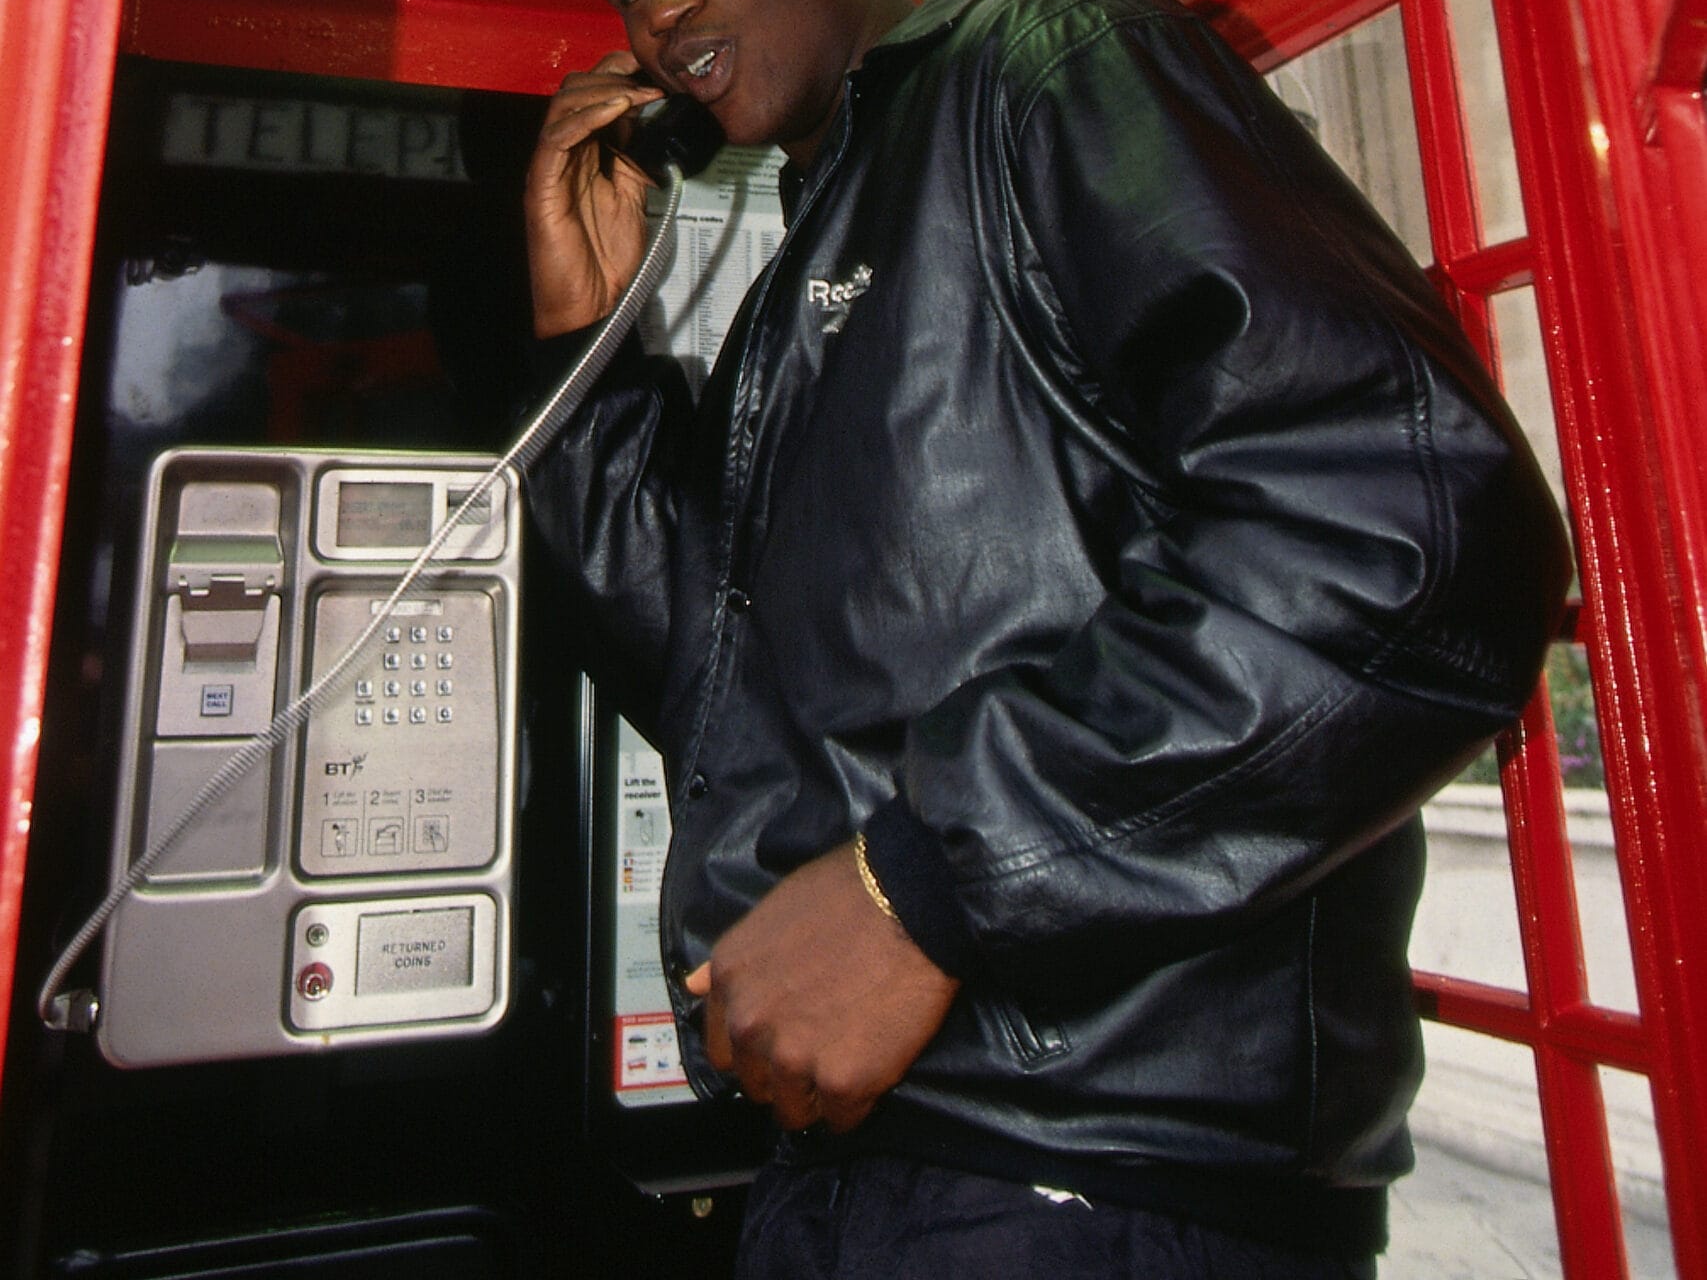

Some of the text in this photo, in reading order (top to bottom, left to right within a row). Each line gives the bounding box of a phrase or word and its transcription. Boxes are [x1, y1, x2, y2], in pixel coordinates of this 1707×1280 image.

[324, 762, 352, 776] BT
[370, 789, 380, 806] 2
[415, 788, 426, 804] 3
[382, 939, 446, 954] RETURNED
[394, 956, 432, 969] COINS
